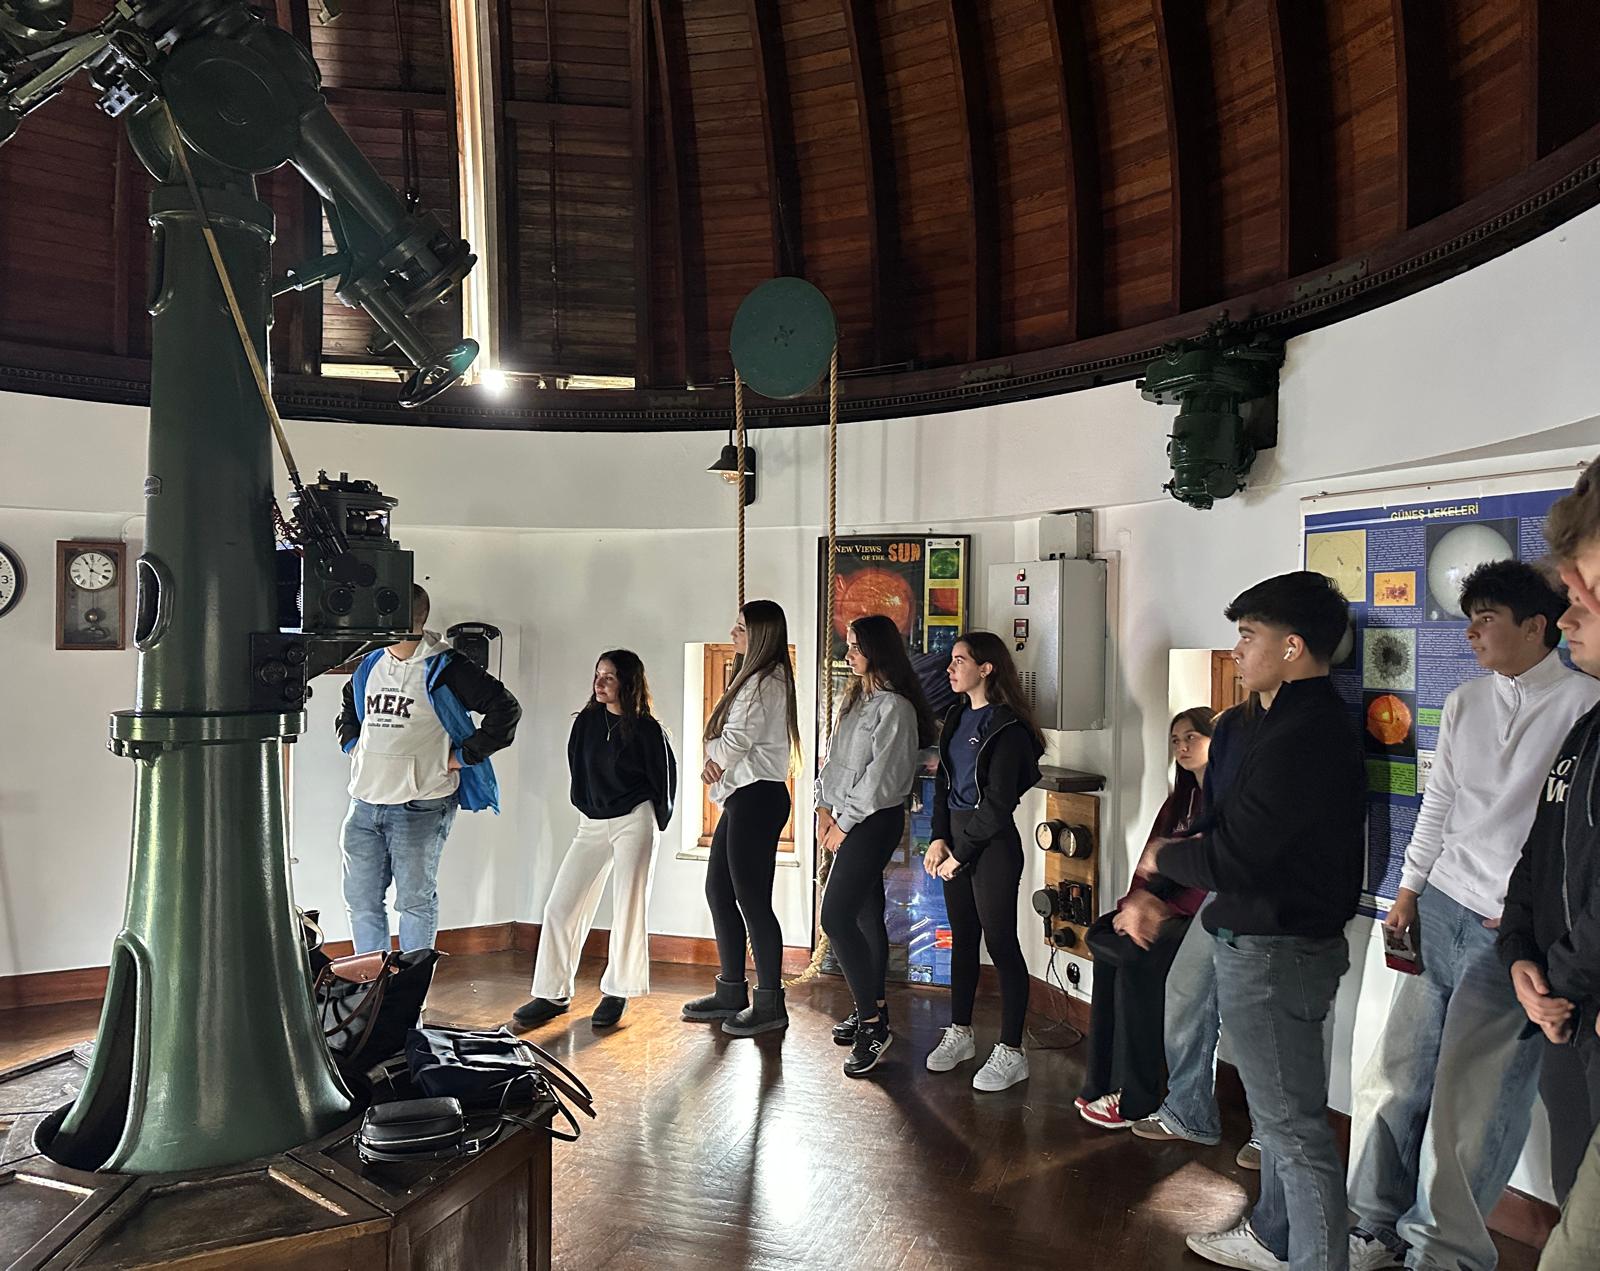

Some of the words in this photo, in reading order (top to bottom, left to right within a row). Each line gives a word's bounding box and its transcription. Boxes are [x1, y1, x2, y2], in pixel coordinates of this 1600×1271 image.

[1427, 502, 1479, 518] LEKELERİ
[834, 545, 854, 553] NEW
[855, 545, 882, 553] VIEWS
[888, 543, 921, 563] SUN
[1, 575, 9, 584] 3
[367, 693, 415, 718] MEK
